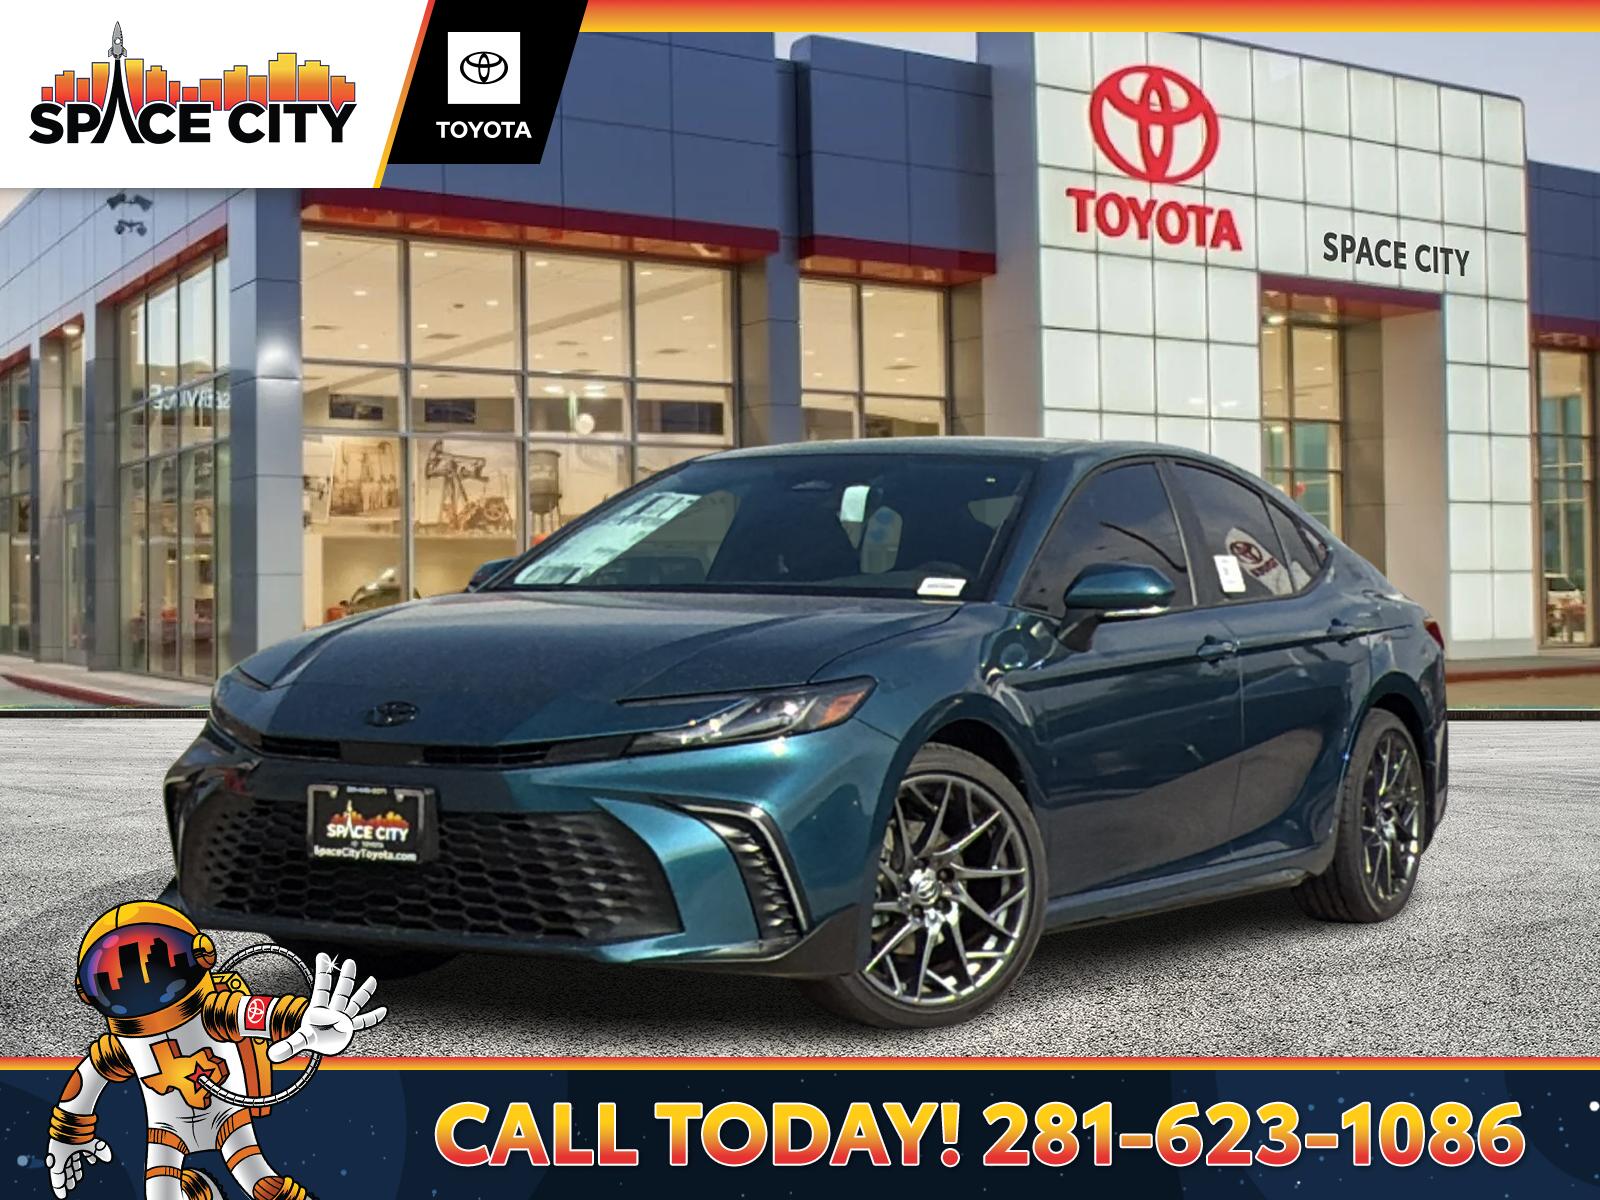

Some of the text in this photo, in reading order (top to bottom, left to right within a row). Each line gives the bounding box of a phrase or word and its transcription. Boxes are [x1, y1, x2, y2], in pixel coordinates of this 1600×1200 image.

[1065, 187, 1242, 251] TOYOTA
[1323, 232, 1470, 277] SPACE CITY
[326, 820, 409, 842] SPACE CITY
